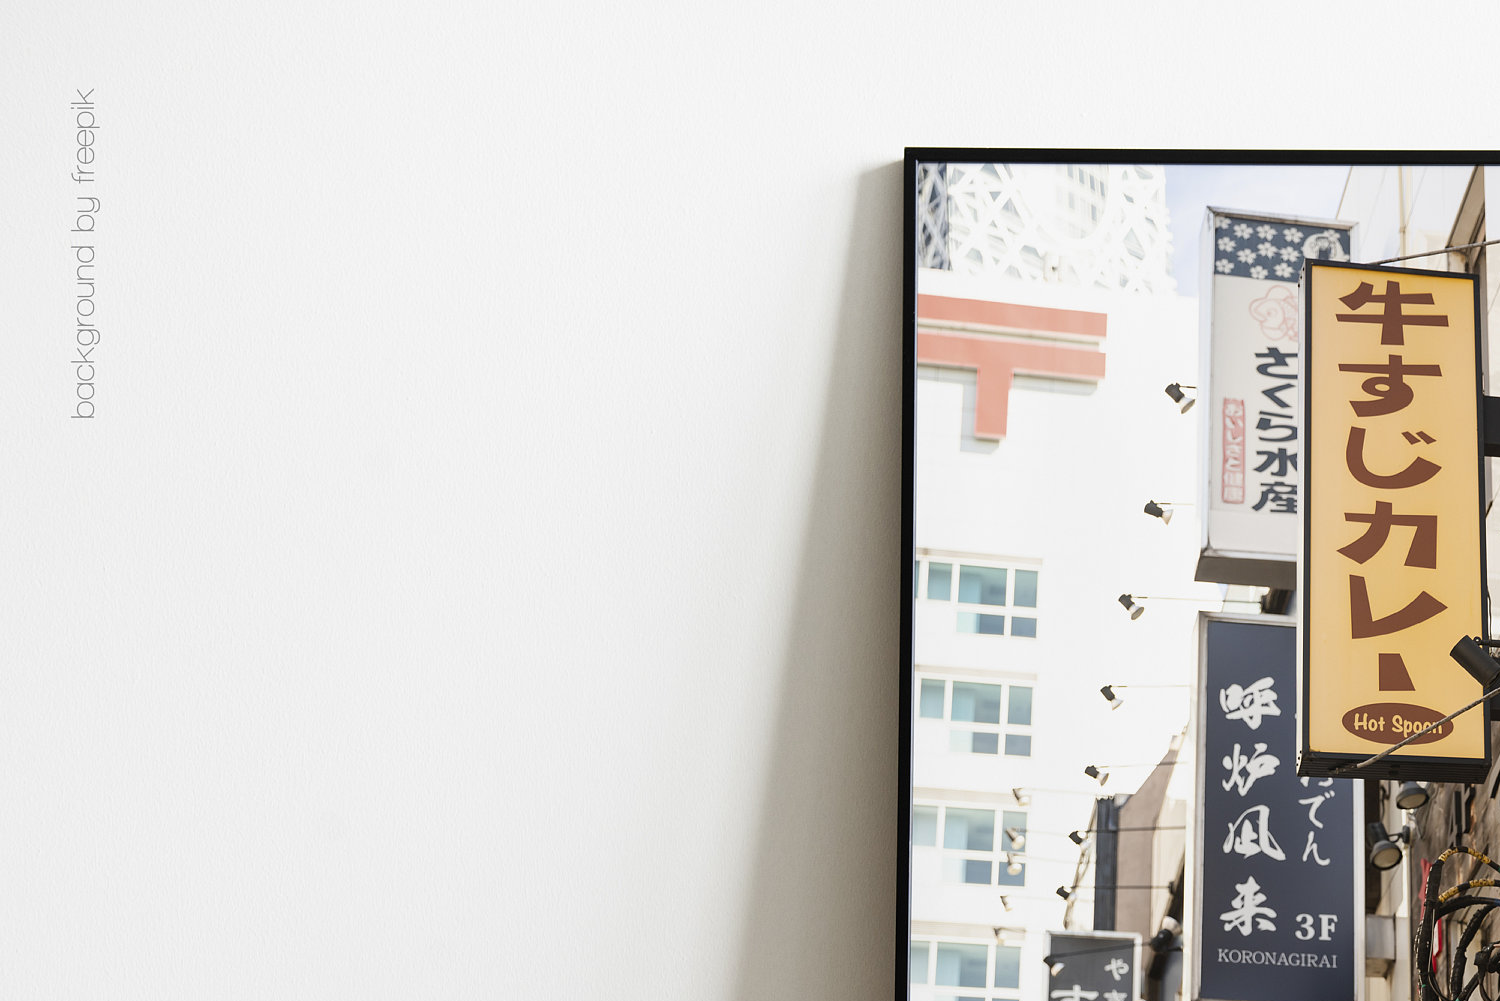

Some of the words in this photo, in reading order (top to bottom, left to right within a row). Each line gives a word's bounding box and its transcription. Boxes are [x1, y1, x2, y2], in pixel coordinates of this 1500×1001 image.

[1252, 347, 1298, 514] さくら水産
[1335, 280, 1450, 692] 牛すじカレー
[1354, 712, 1386, 732] Hot
[1295, 912, 1338, 941] 3F
[1217, 948, 1338, 969] KORONAGIRAI
